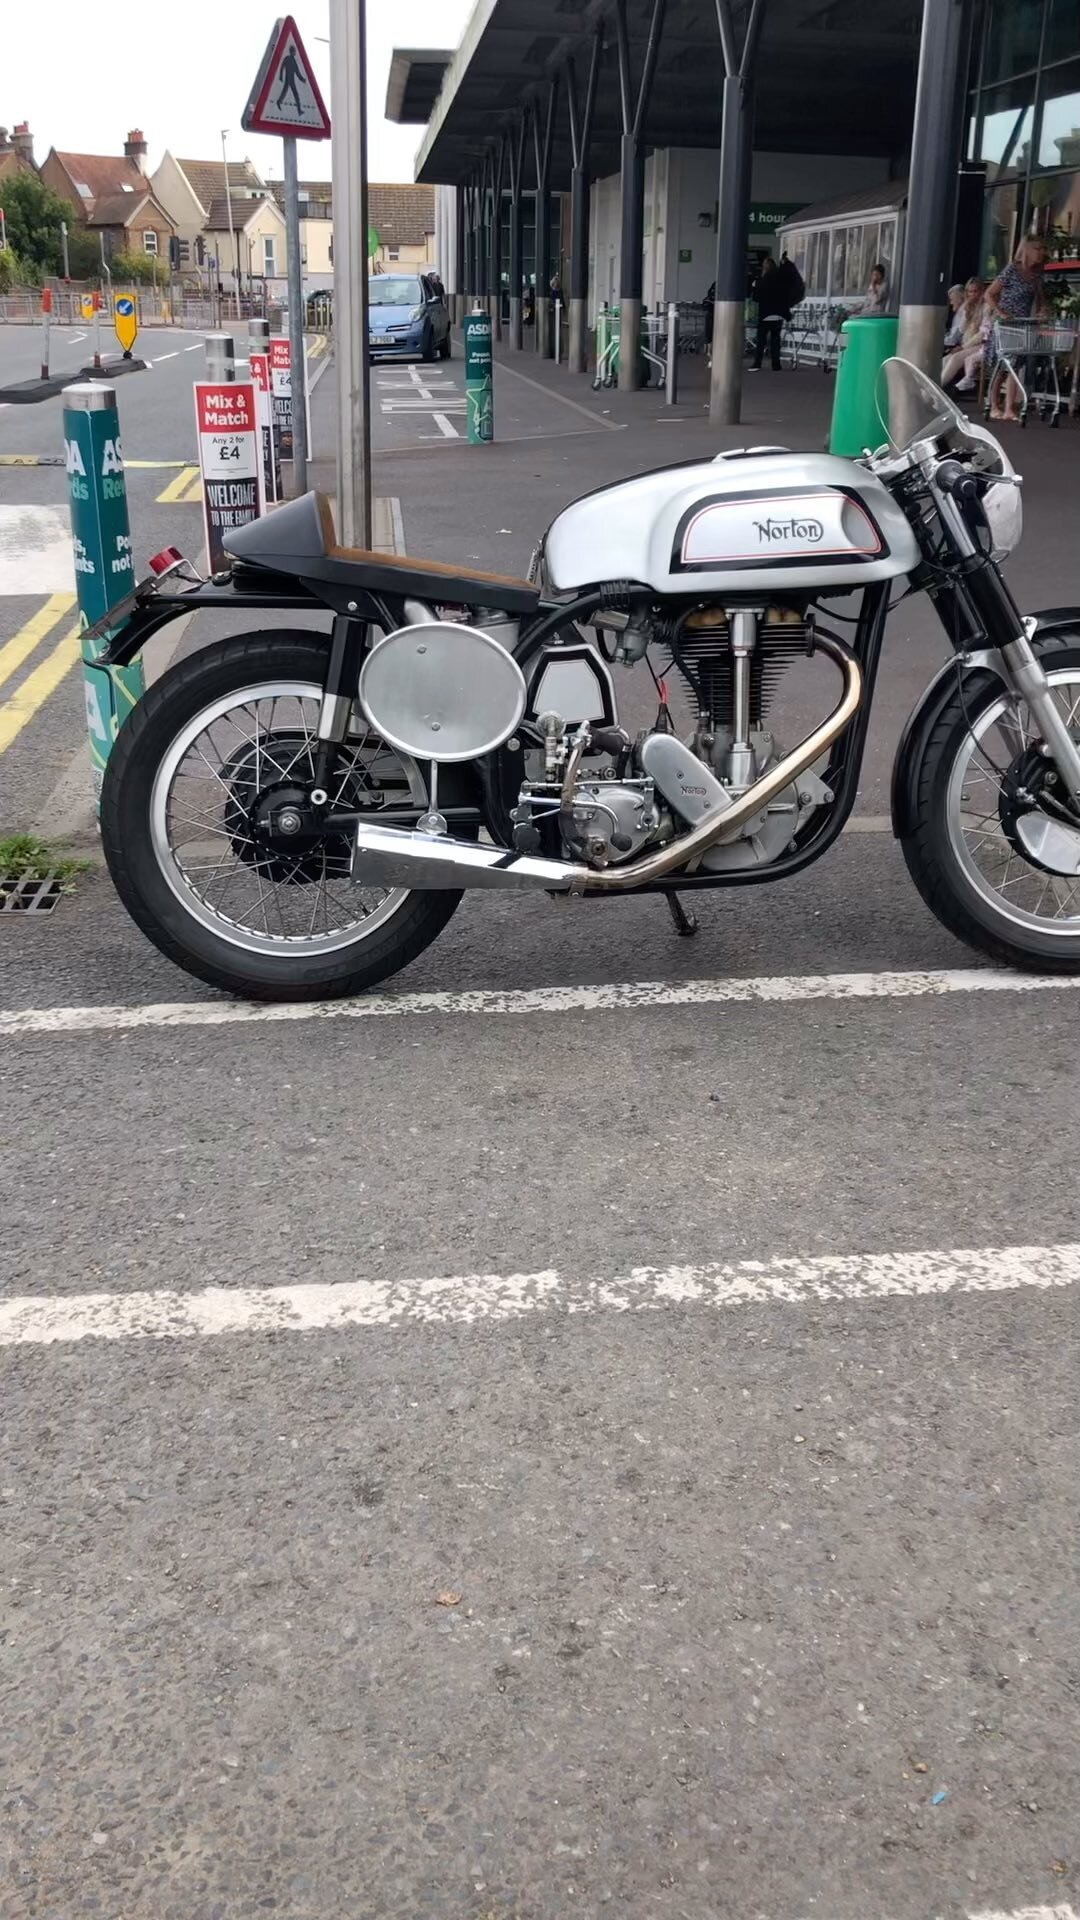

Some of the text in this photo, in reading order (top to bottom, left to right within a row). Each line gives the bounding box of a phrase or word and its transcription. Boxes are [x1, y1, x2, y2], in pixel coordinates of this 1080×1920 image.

[759, 212, 786, 223] hour
[467, 323, 489, 336] ASD
[273, 345, 289, 355] Mix
[273, 355, 292, 365] Matc
[205, 394, 247, 409] Mix &
[204, 410, 249, 426] Match
[212, 435, 245, 445] Any 2 for
[219, 445, 241, 461] £4
[207, 483, 257, 508] WELCOME
[210, 510, 220, 527] TO
[220, 510, 235, 527] THE
[752, 518, 824, 544] Norton
[681, 785, 707, 797] Norton
